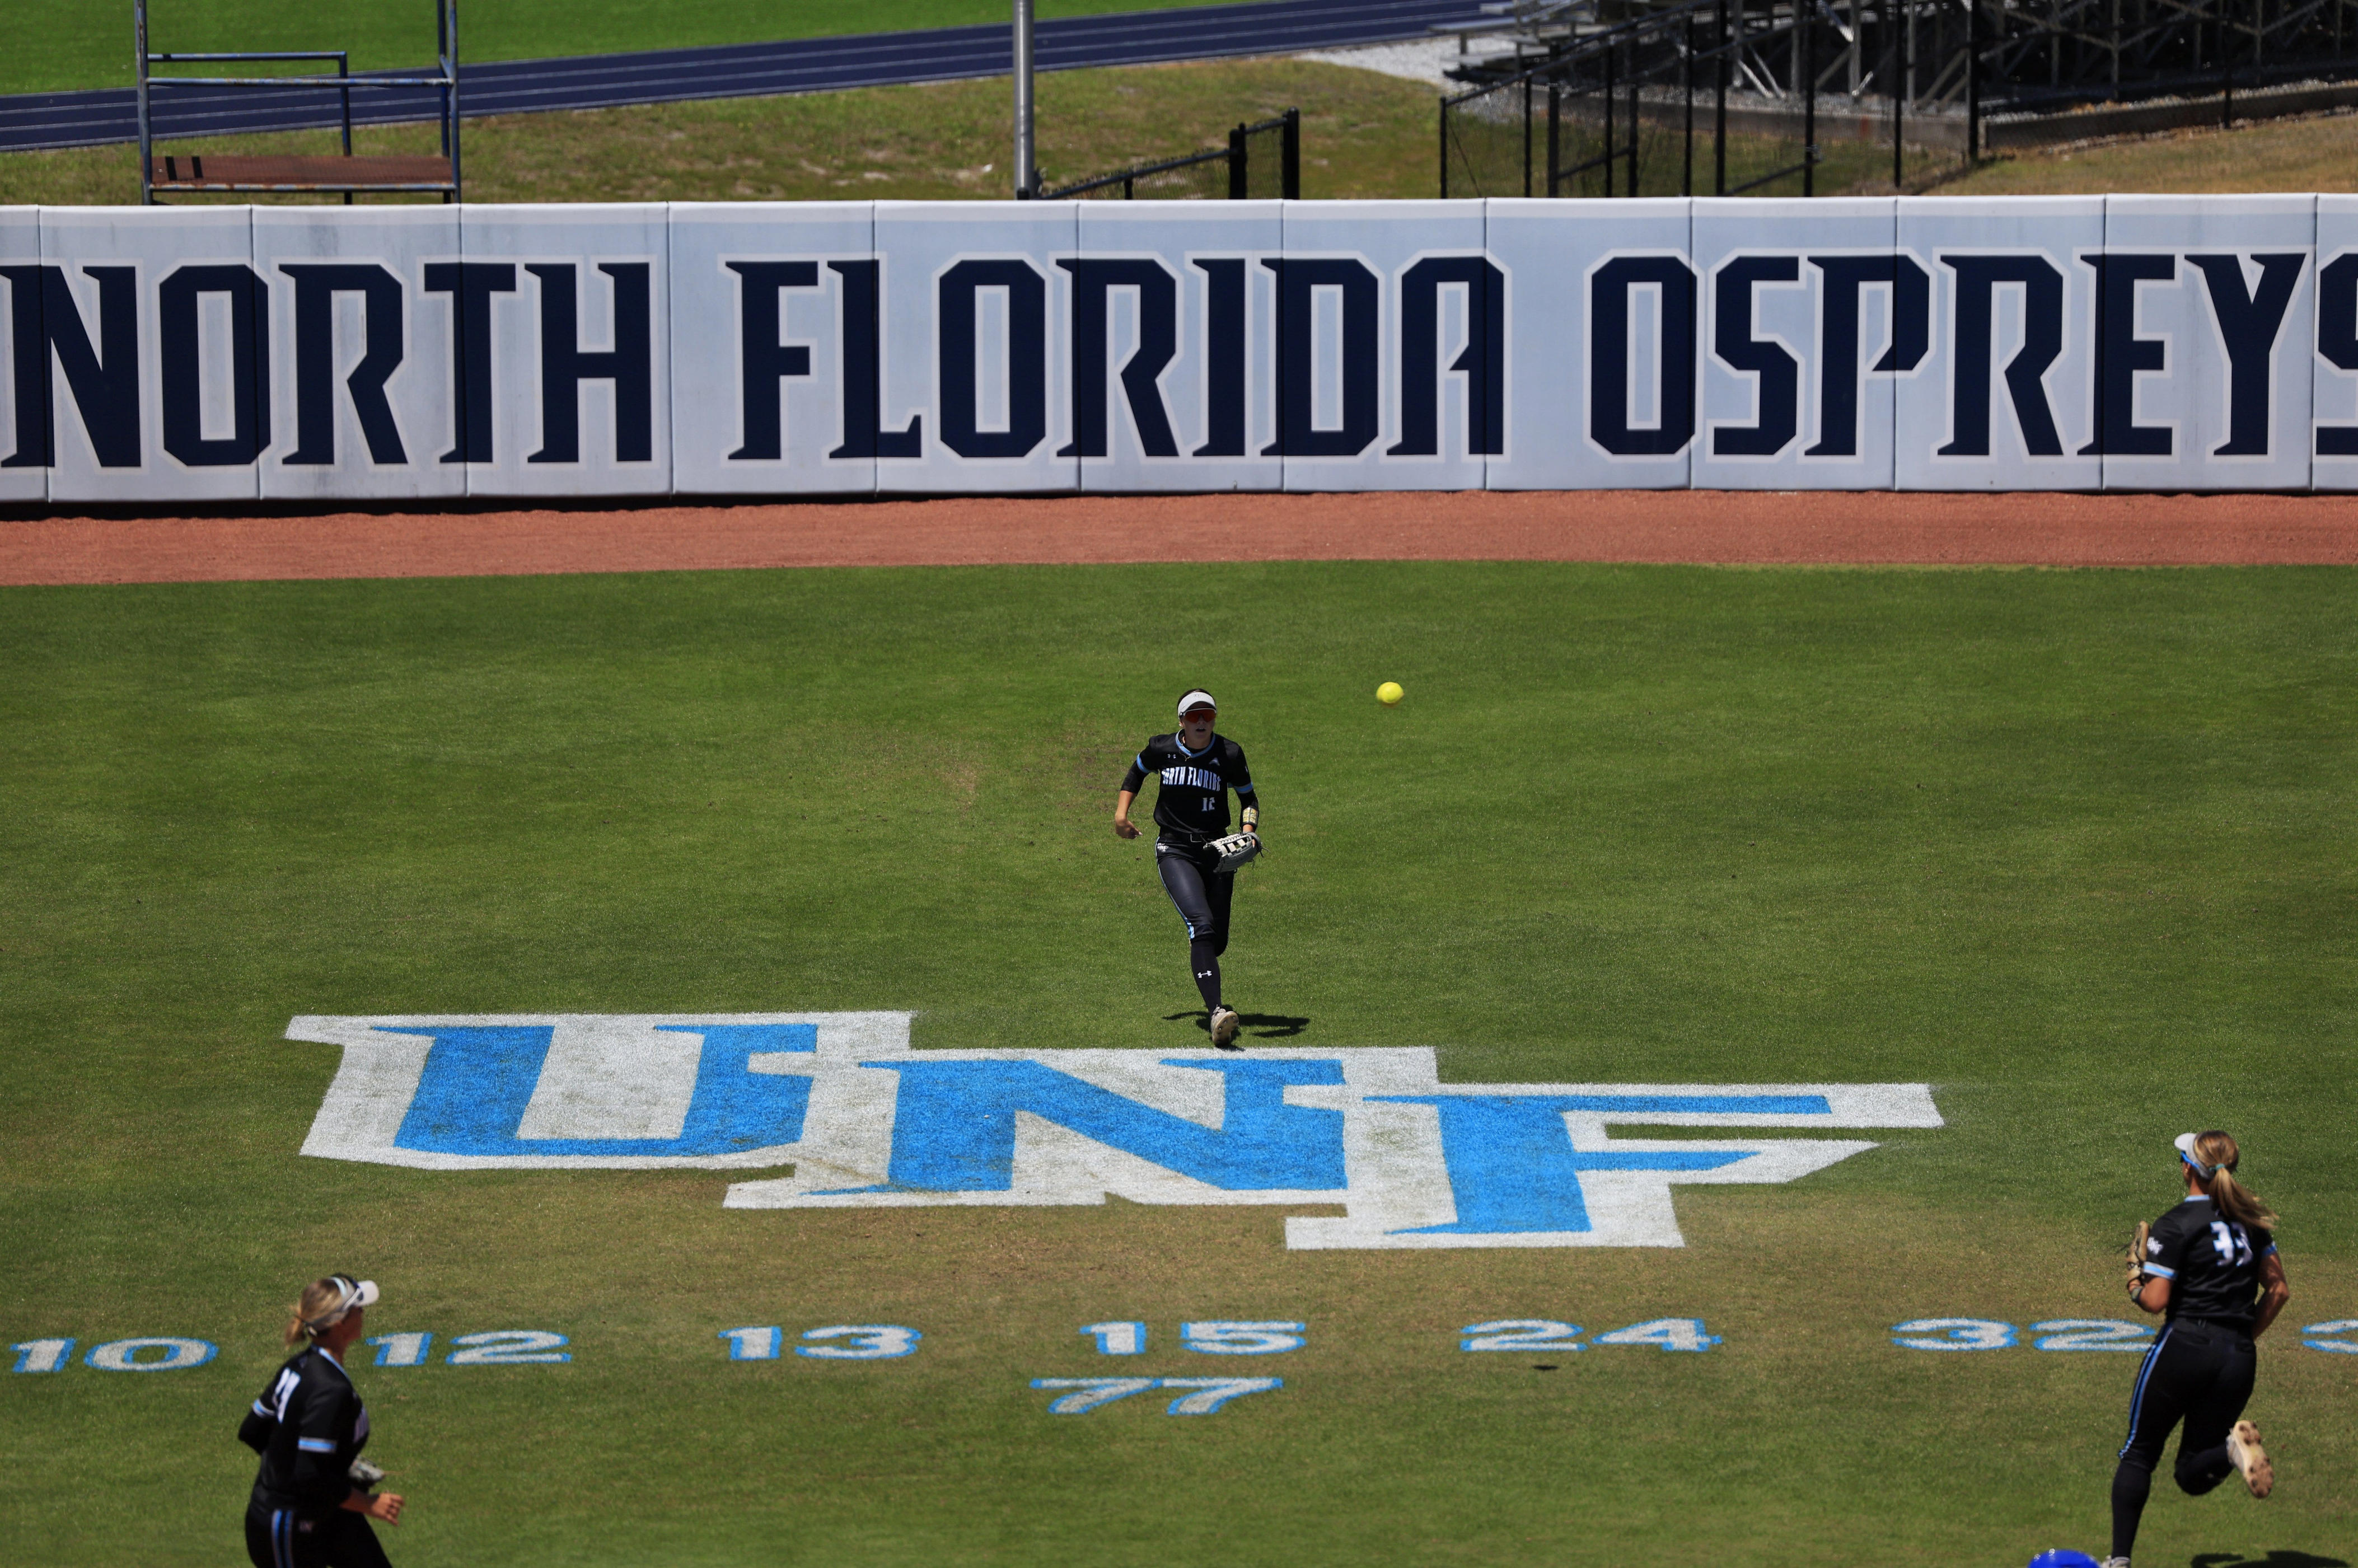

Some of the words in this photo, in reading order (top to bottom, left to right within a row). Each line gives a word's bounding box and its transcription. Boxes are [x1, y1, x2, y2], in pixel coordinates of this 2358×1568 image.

[0, 262, 653, 469] NORTH
[724, 256, 1505, 460] FLORIDA
[284, 1009, 1945, 1251] UNF
[2210, 1220, 2254, 1267] 33
[10, 1337, 219, 1373] 10
[365, 1330, 572, 1367] 12
[718, 1324, 923, 1361] 13
[1080, 1320, 1307, 1356] 15
[1459, 1318, 1723, 1353] 24
[1892, 1317, 2157, 1352] 32
[1029, 1377, 1284, 1416] 77
